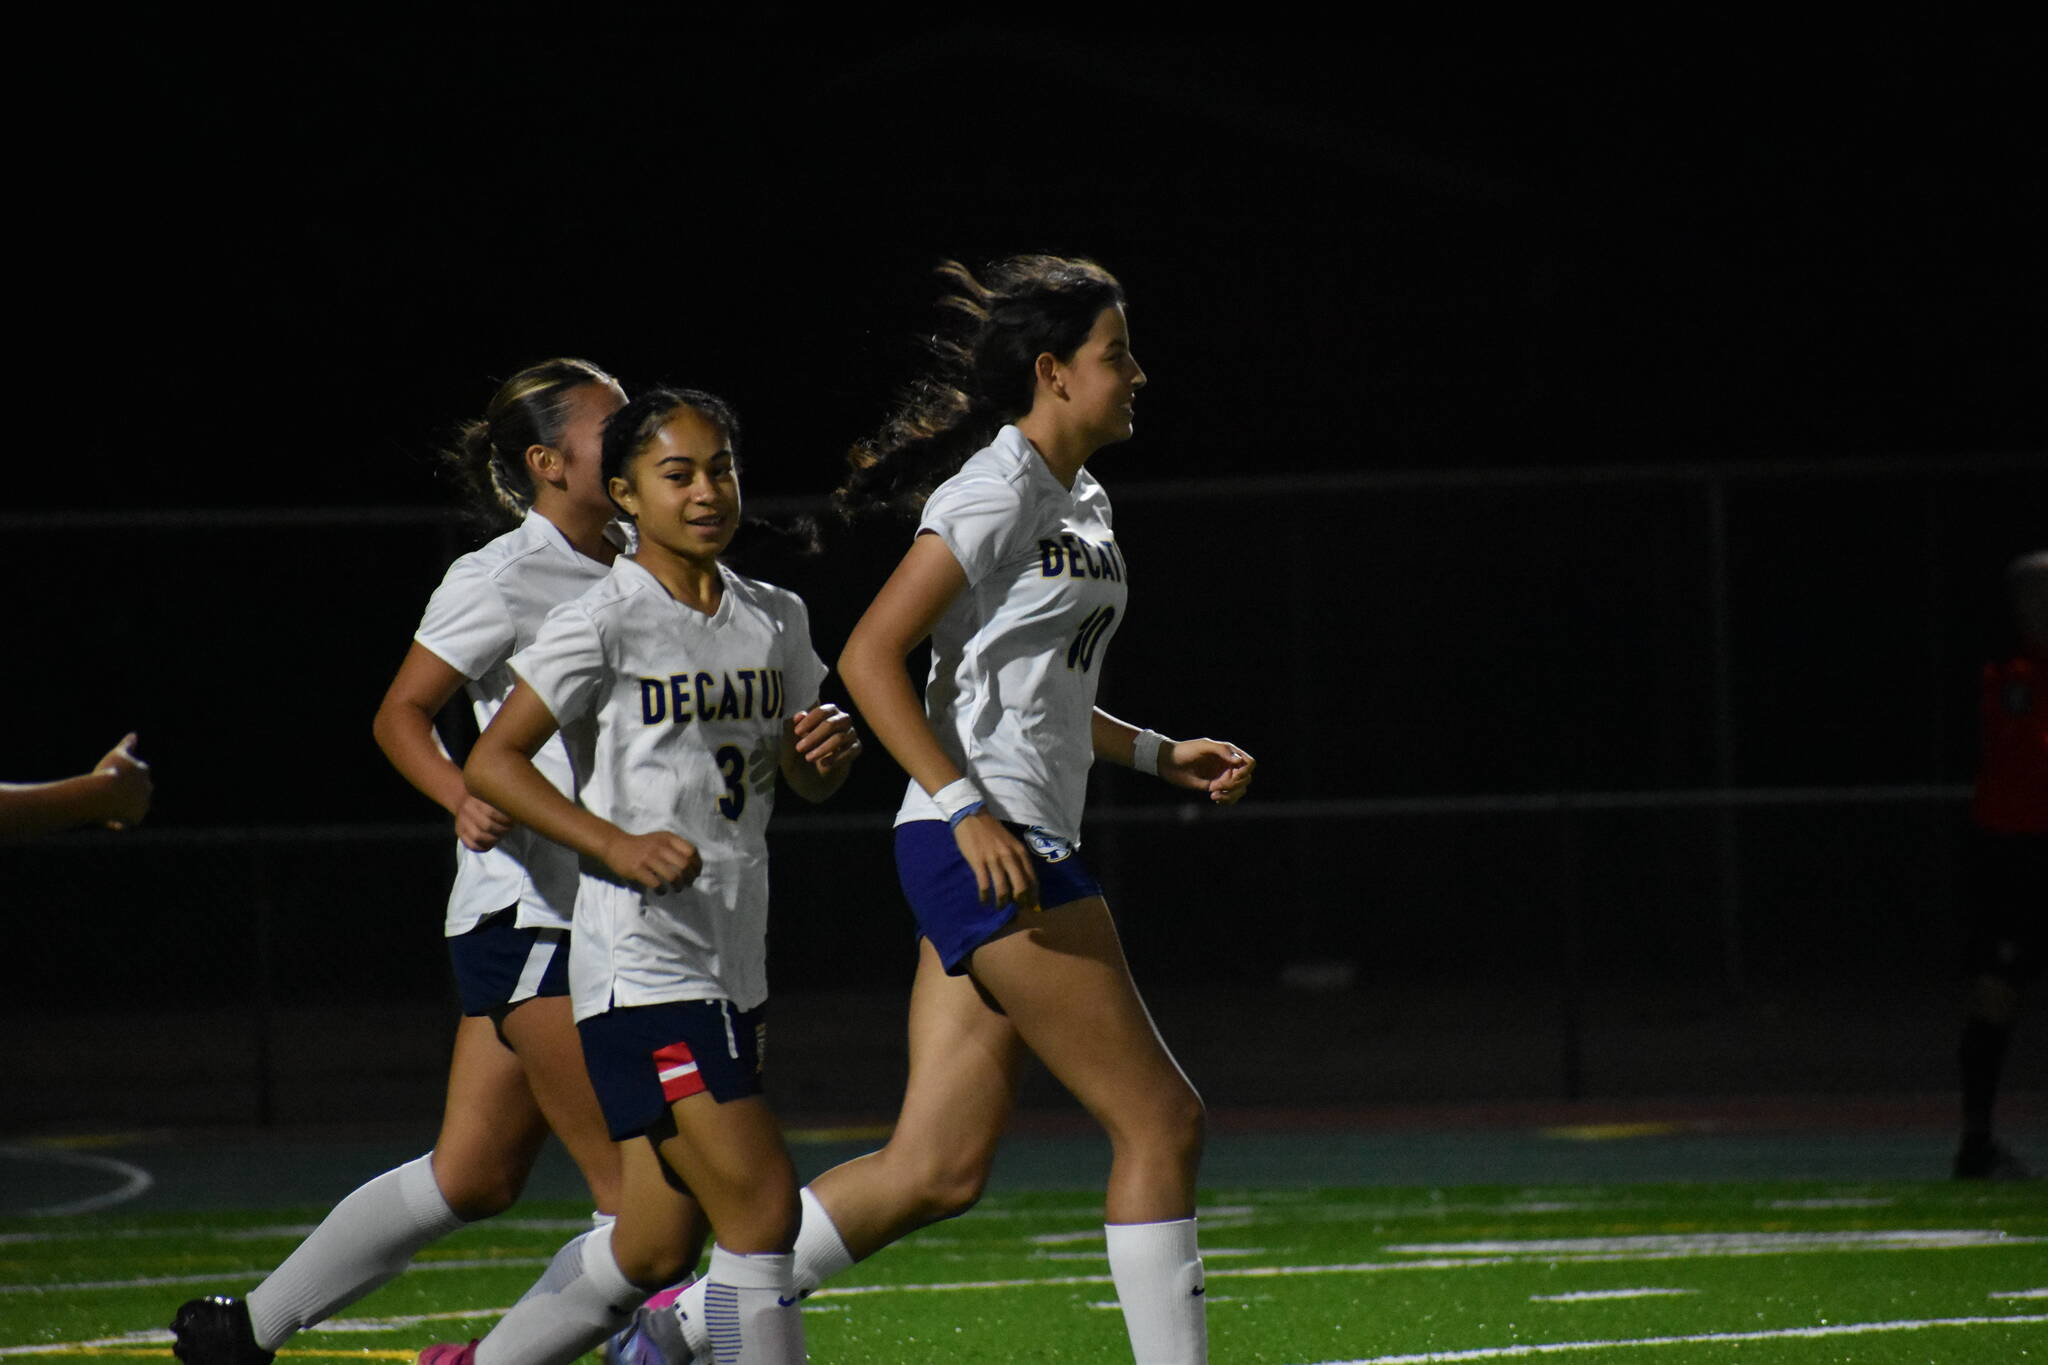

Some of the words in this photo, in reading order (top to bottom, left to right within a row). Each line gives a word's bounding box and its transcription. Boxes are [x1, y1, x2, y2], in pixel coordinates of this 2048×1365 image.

[1038, 533, 1127, 583] DECAT
[1066, 605, 1115, 673] 10
[713, 743, 746, 823] 3
